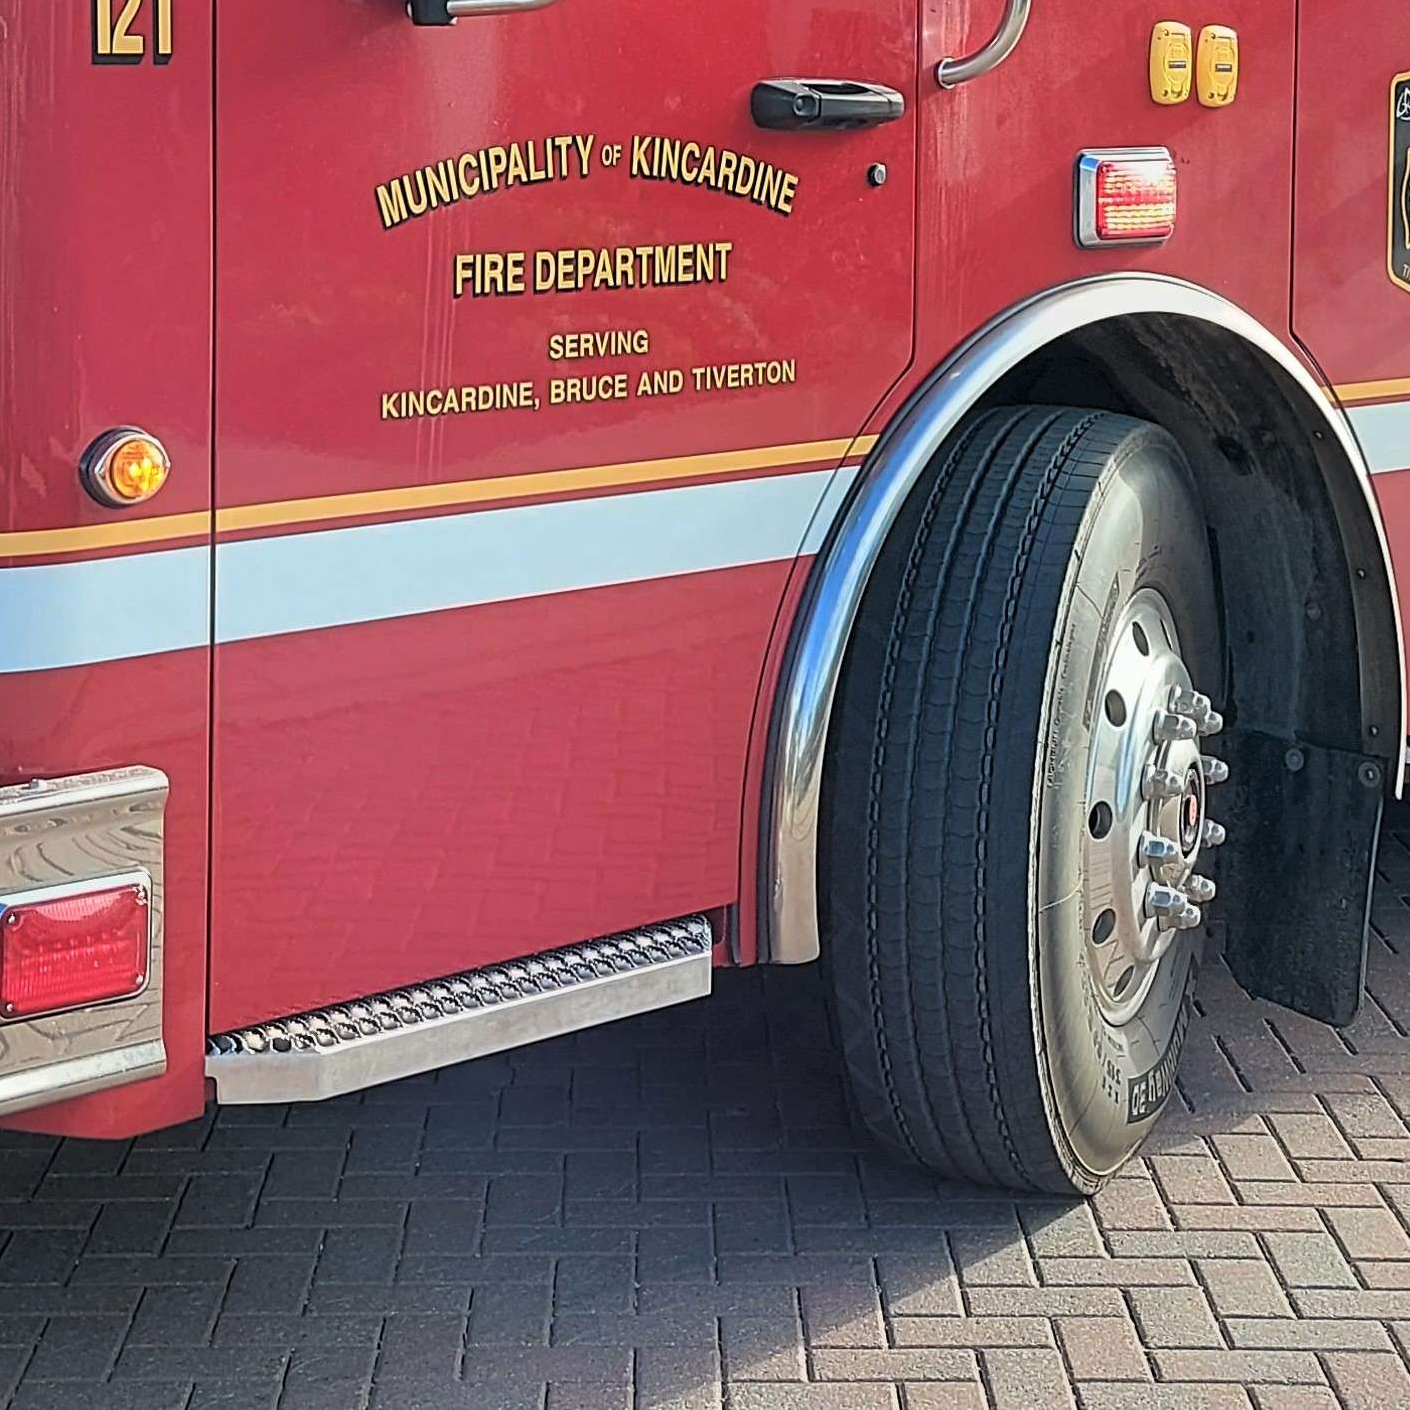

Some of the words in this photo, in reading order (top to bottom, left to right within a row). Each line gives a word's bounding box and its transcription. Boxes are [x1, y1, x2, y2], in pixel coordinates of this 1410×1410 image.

[375, 133, 595, 229] MUNICIPALITY
[601, 143, 623, 168] OF
[630, 134, 800, 215] KINCARDINE
[454, 252, 525, 298] FIRE
[534, 242, 733, 294] DEPARTMENT
[549, 329, 649, 360] SERVING
[380, 381, 541, 420] KINCARDINE,
[549, 373, 628, 405] BRUCE
[636, 369, 684, 397] AND
[691, 359, 797, 391] TIVERTON
